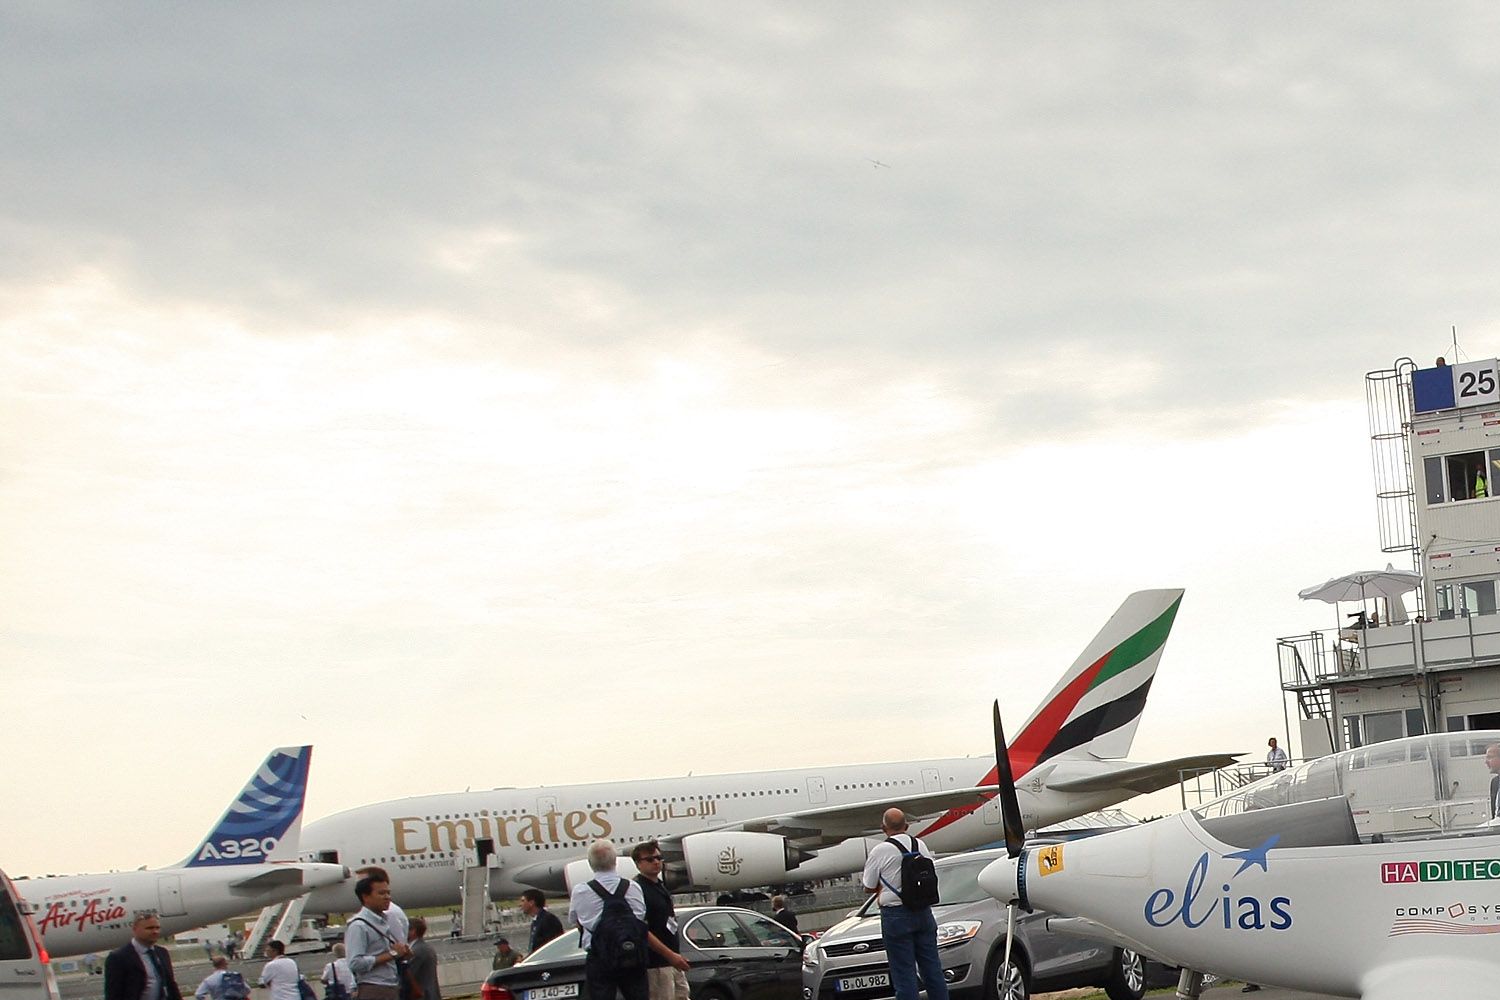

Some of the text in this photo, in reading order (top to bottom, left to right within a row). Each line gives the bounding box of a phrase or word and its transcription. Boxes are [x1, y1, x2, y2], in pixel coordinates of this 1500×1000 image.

[1459, 368, 1496, 398] 25
[390, 807, 613, 856] Emirates
[198, 836, 278, 861] A320
[1144, 851, 1293, 930] elias
[868, 975, 887, 987] 982
